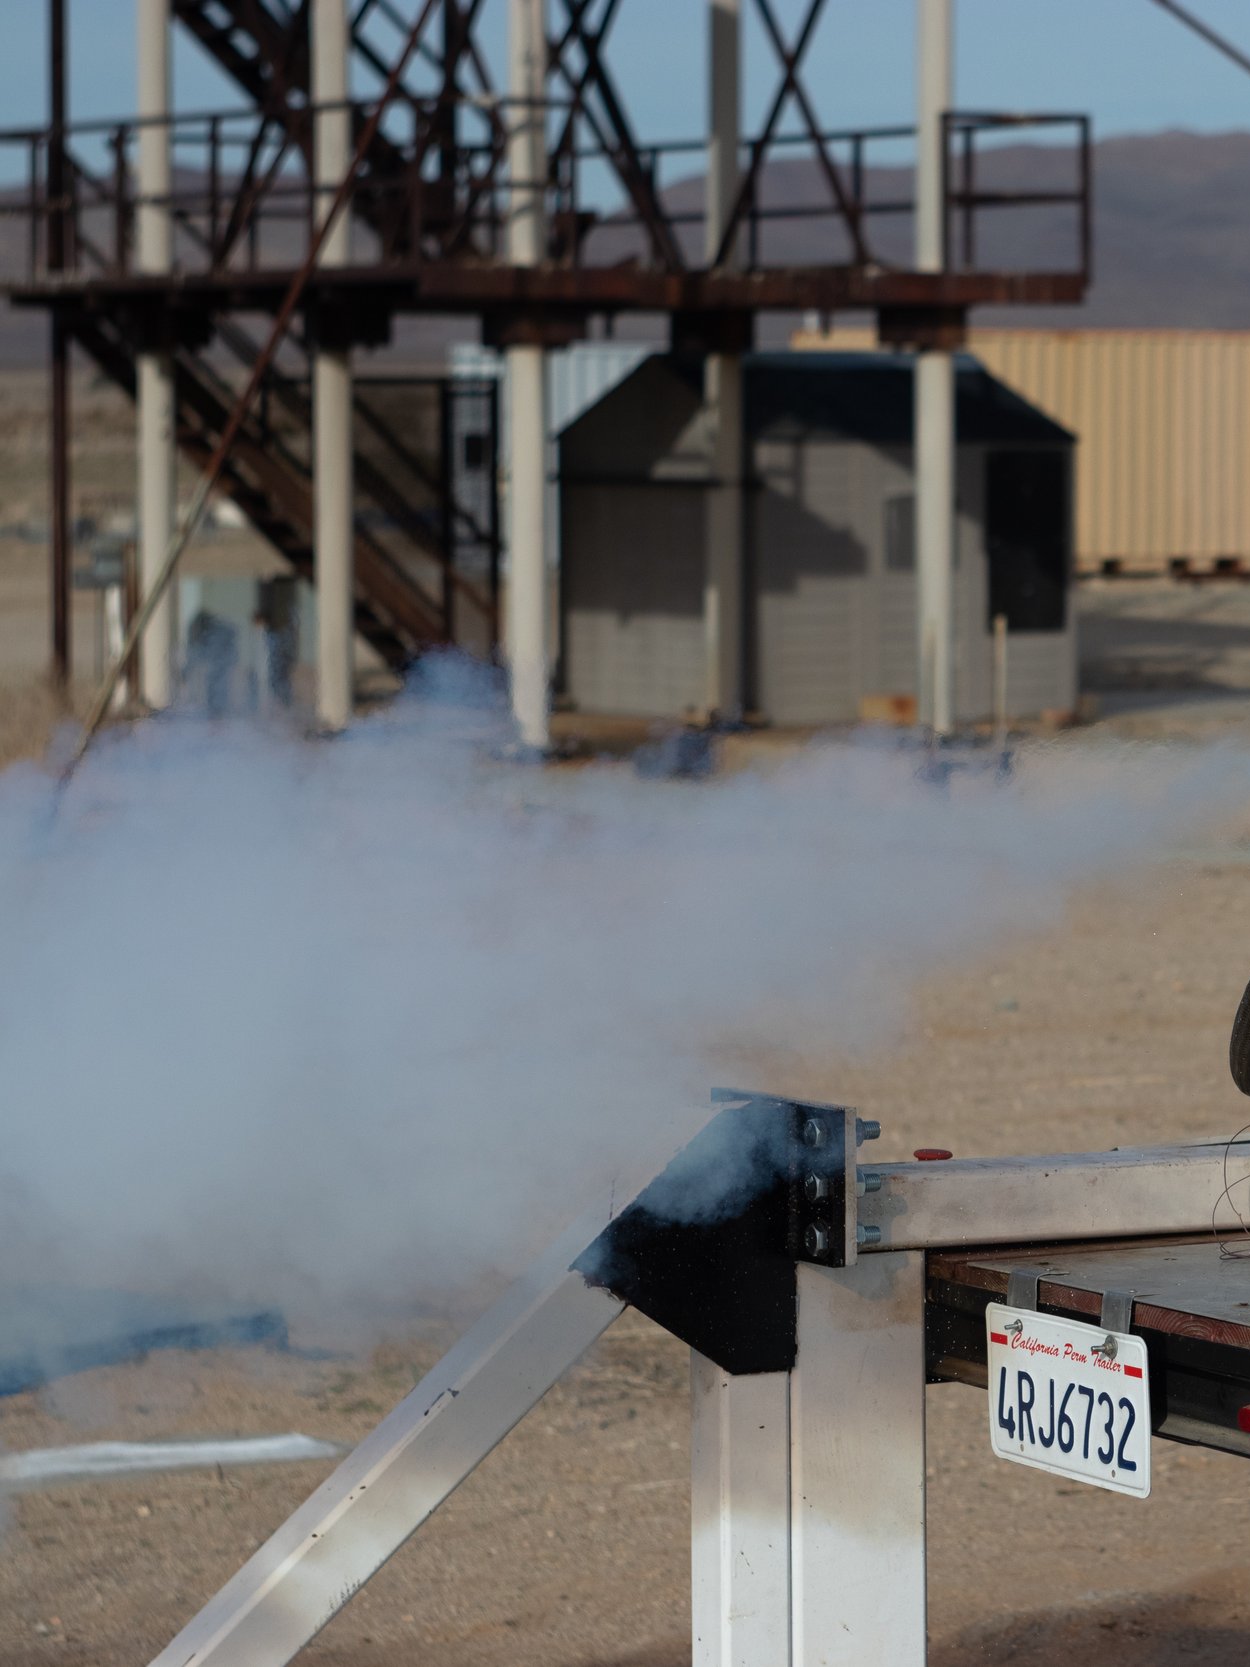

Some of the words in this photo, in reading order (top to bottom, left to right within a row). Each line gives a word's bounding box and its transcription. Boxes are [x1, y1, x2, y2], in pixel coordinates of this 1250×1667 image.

[1011, 1330, 1060, 1356] California
[1062, 1343, 1088, 1364] Perm
[1091, 1350, 1122, 1373] Trailer
[999, 1366, 1137, 1472] 4RJ6732
